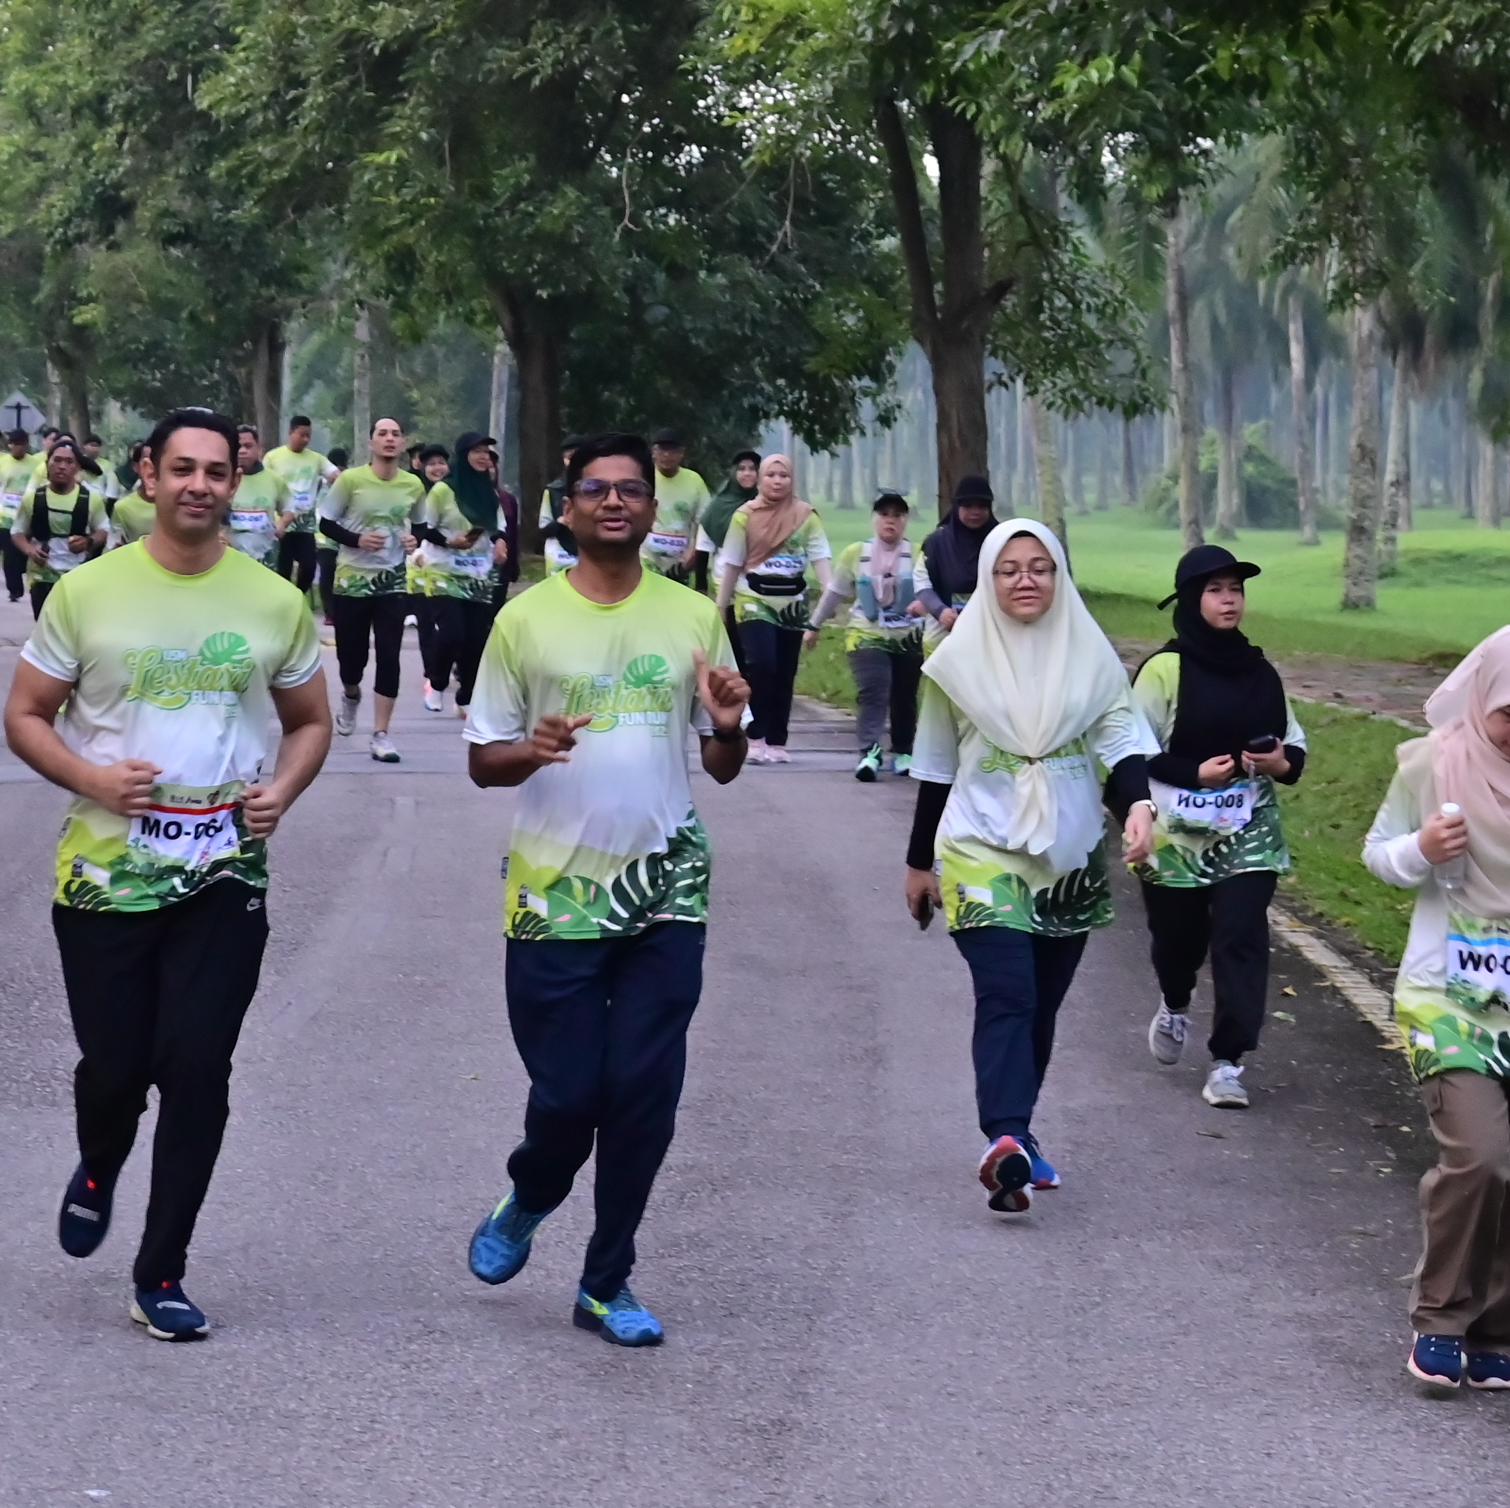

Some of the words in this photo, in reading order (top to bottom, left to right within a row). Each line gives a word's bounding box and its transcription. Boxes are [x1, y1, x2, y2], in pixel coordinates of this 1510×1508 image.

[119, 645, 257, 710] Lestari
[191, 690, 220, 705] FUN
[558, 672, 674, 733] Lestari
[618, 712, 645, 726] FUN
